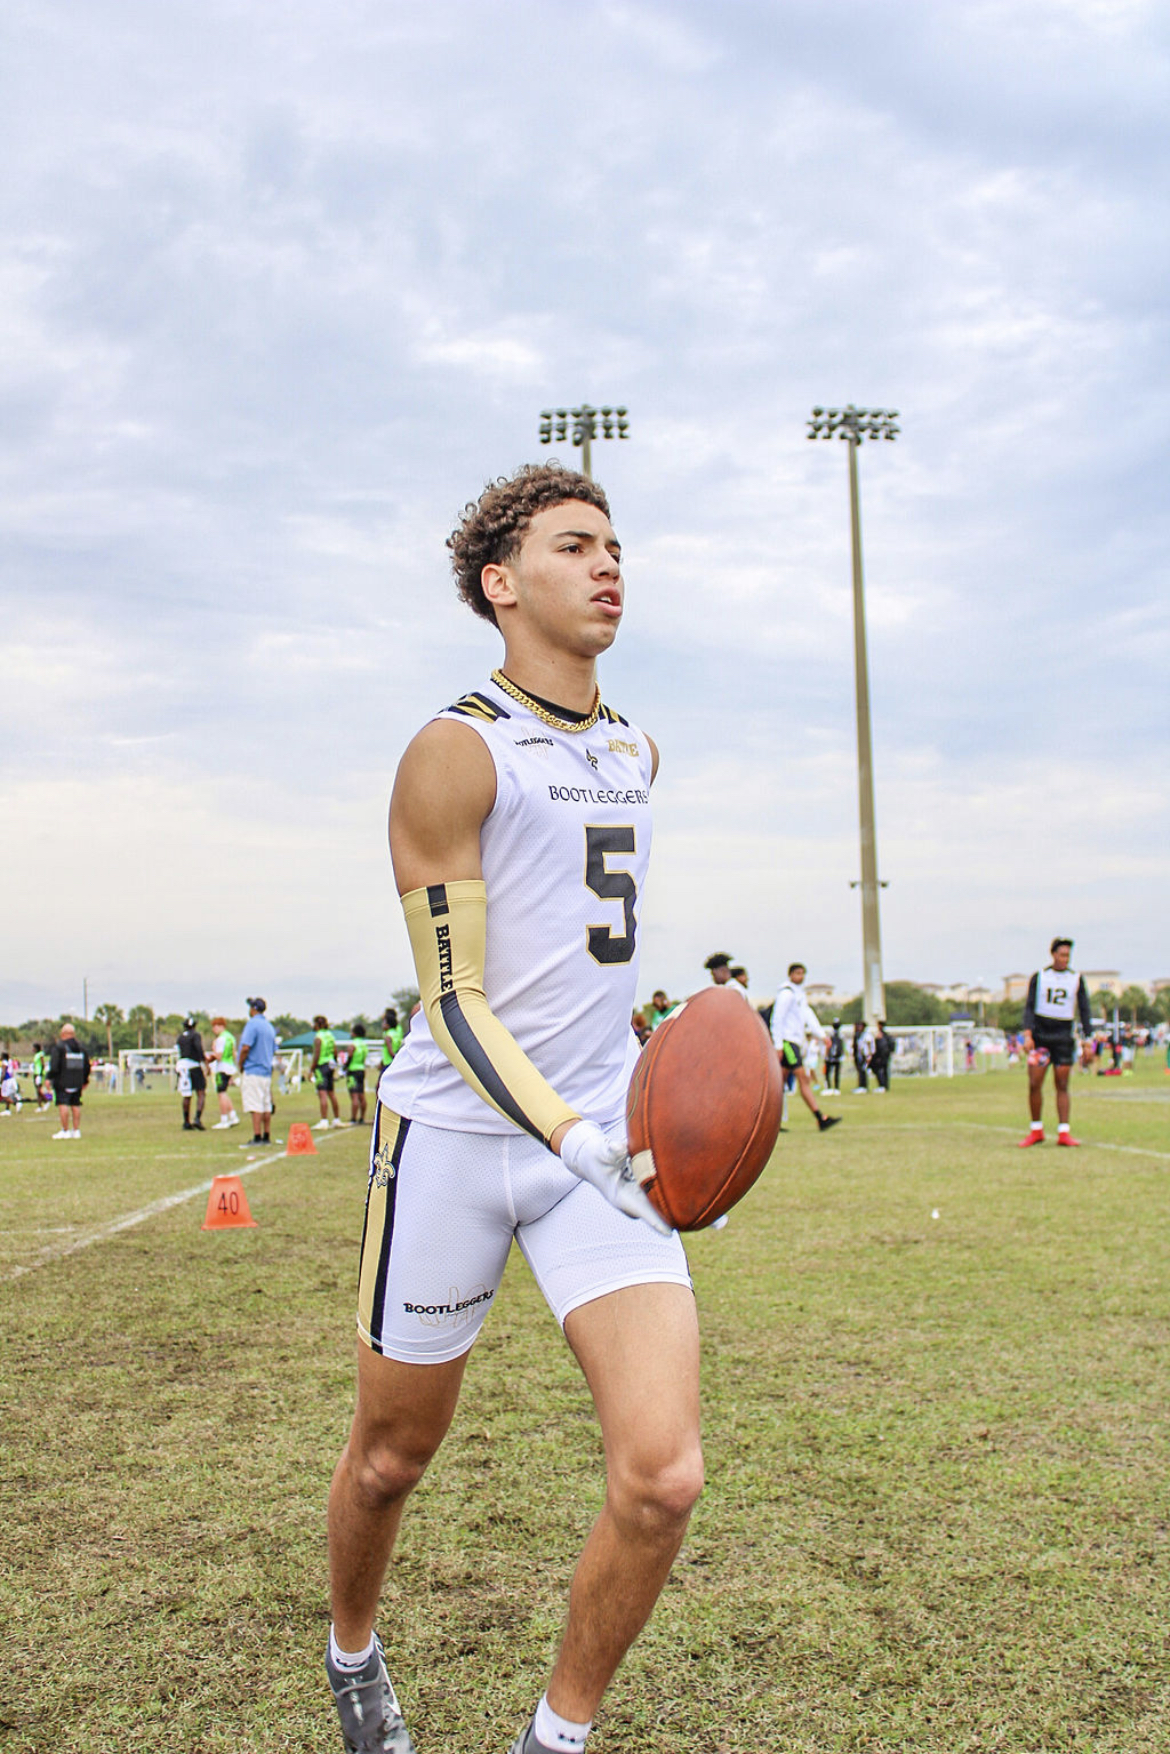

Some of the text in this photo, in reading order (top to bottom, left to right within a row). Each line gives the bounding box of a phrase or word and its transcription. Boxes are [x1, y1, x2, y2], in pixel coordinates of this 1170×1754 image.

[548, 785, 648, 804] BOOTLEGGERS
[584, 824, 637, 966] 5
[435, 923, 454, 993] BATTLE
[1046, 987, 1067, 1005] 12
[218, 1191, 239, 1215] 40
[403, 1289, 494, 1315] BOOTLEGGERS
